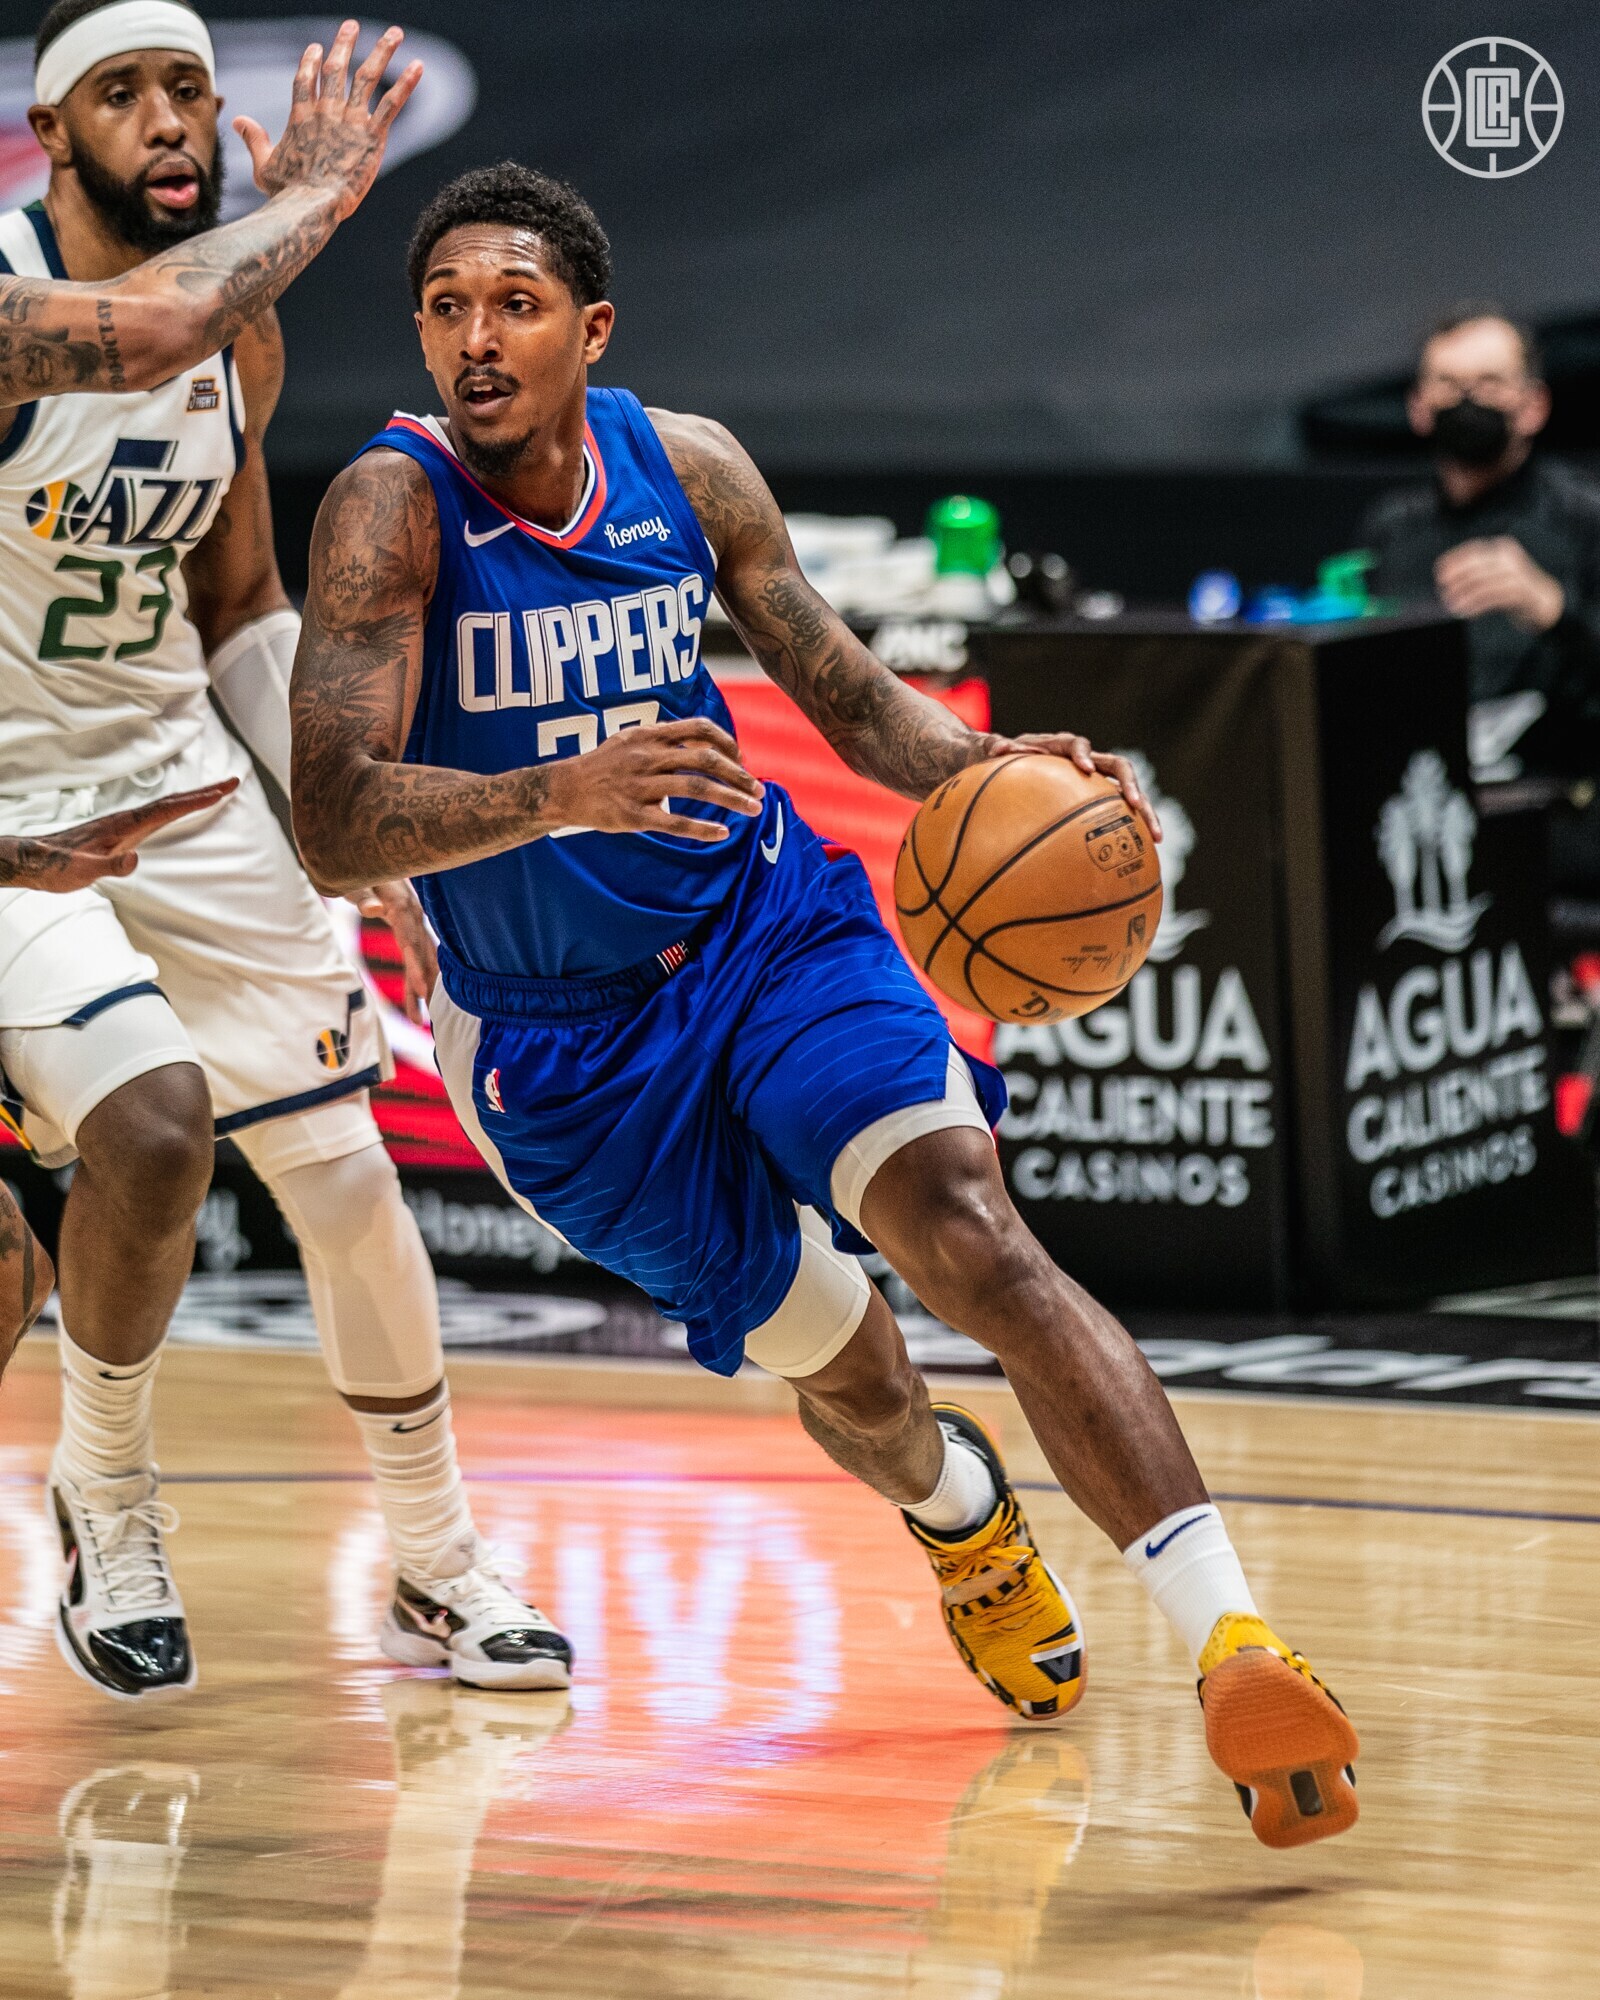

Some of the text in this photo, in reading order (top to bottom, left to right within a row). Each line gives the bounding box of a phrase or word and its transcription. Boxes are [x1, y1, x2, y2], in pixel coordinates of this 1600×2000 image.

[604, 516, 671, 549] honey
[38, 546, 178, 662] 23
[457, 573, 704, 713] CLIPPERS
[1345, 940, 1544, 1092] AGUA
[998, 1070, 1275, 1148] CALIENTE
[1347, 1044, 1548, 1164] CALIENTE
[1012, 1147, 1250, 1207] CASINOS
[1370, 1124, 1537, 1219] CASINOS
